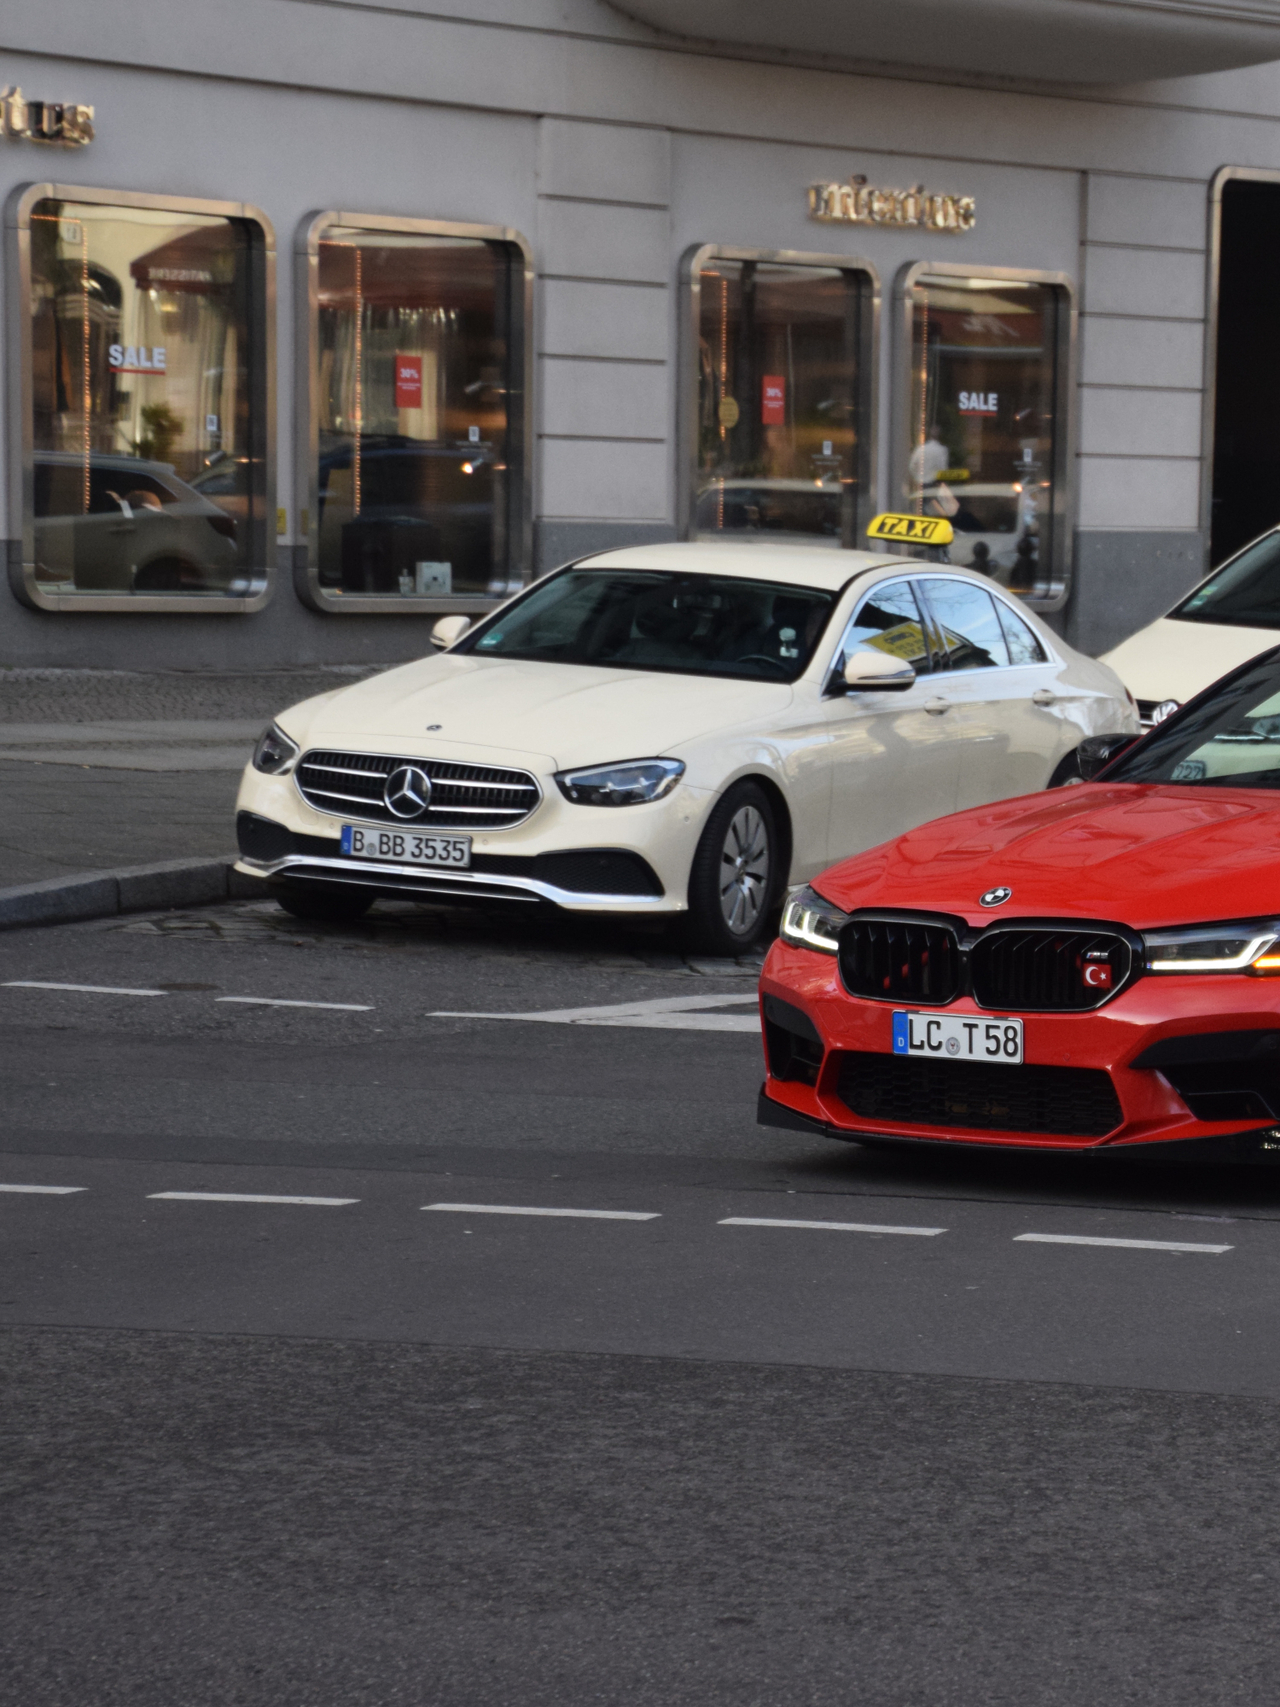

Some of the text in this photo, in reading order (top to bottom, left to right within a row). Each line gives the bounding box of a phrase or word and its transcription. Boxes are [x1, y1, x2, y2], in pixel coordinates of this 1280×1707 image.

[0, 84, 95, 146] tus
[108, 344, 166, 369] SALE
[958, 391, 998, 411] SALE
[883, 517, 936, 538] TAXI
[353, 830, 465, 862] B BB 3535
[909, 1019, 942, 1051] LC
[963, 1023, 979, 1054] T
[985, 1024, 1019, 1057] 58
